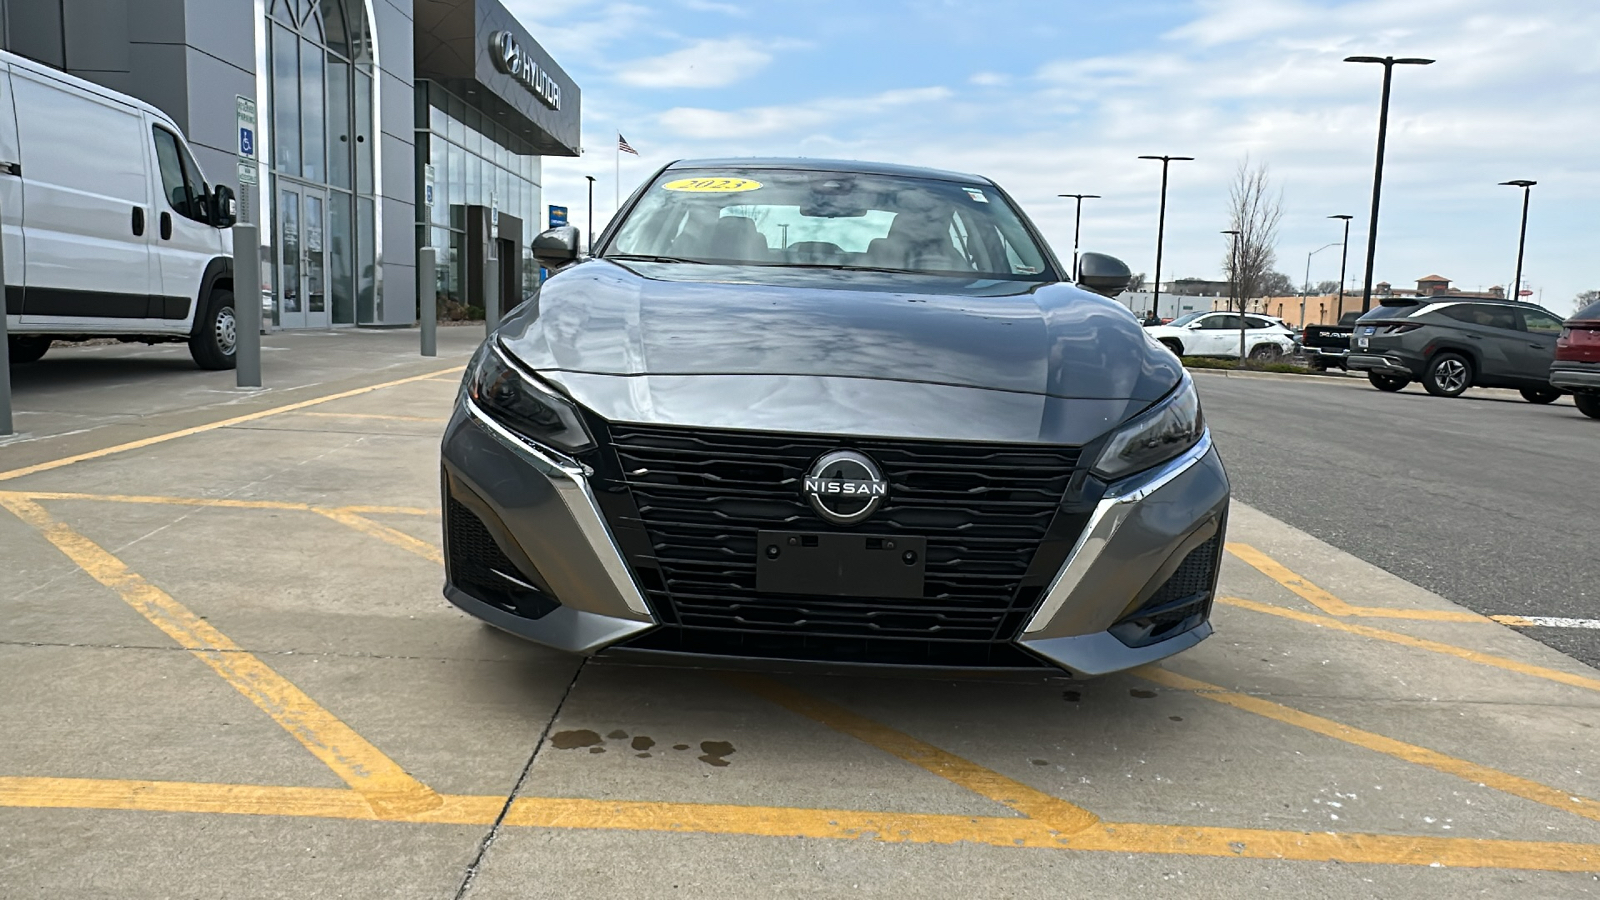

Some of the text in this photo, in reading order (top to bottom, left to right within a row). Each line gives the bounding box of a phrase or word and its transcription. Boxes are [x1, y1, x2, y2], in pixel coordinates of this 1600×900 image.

[523, 51, 560, 111] HYUNDAI
[678, 180, 747, 189] 2023
[805, 480, 885, 494] NISSAN
